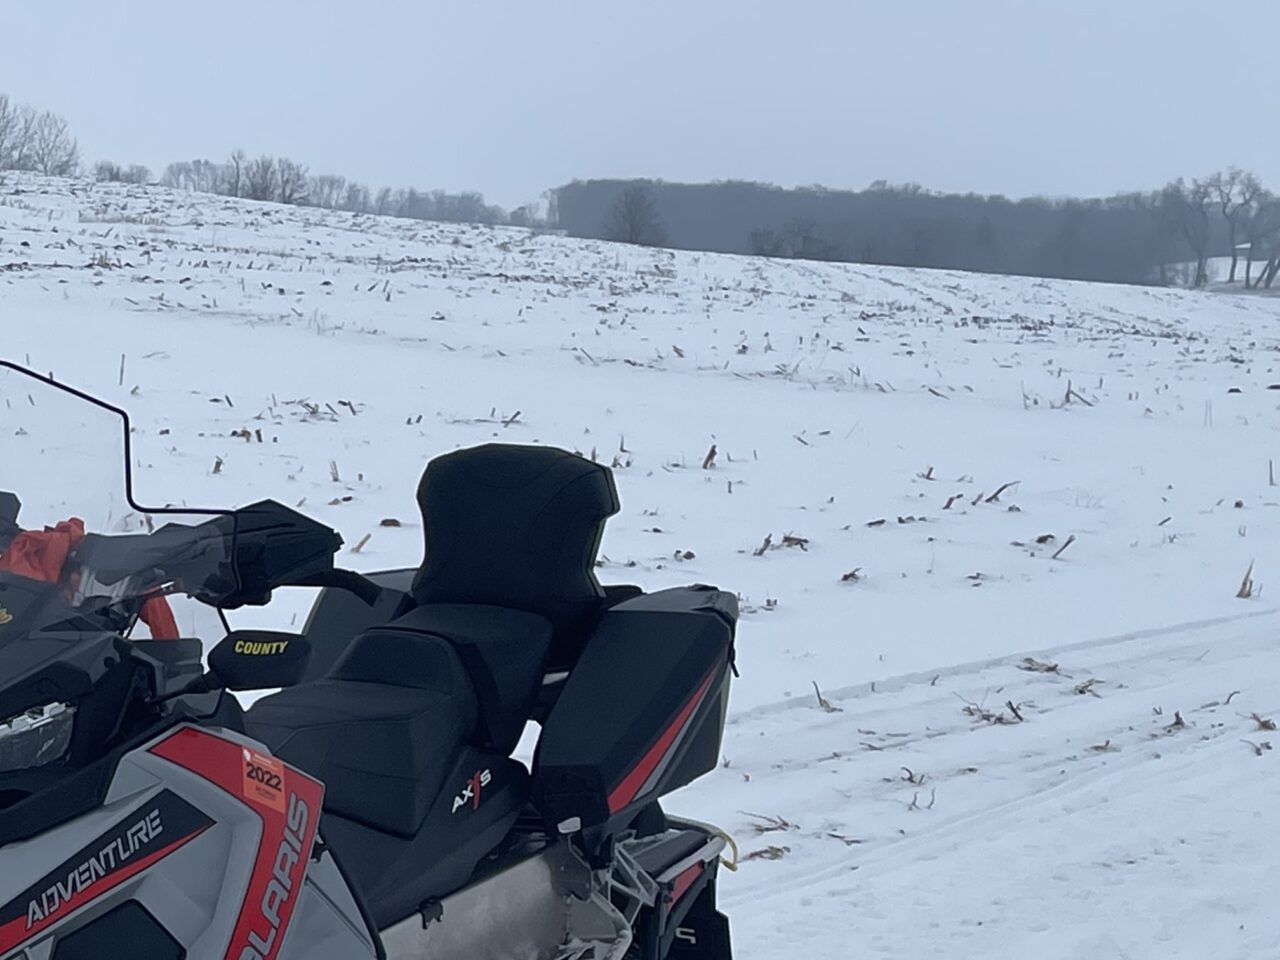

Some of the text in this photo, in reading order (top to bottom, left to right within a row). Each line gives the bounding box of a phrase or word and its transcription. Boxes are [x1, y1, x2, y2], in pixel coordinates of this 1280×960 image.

[235, 640, 288, 655] COUNTY
[246, 762, 282, 792] 2022
[26, 808, 164, 930] ADVENTURE
